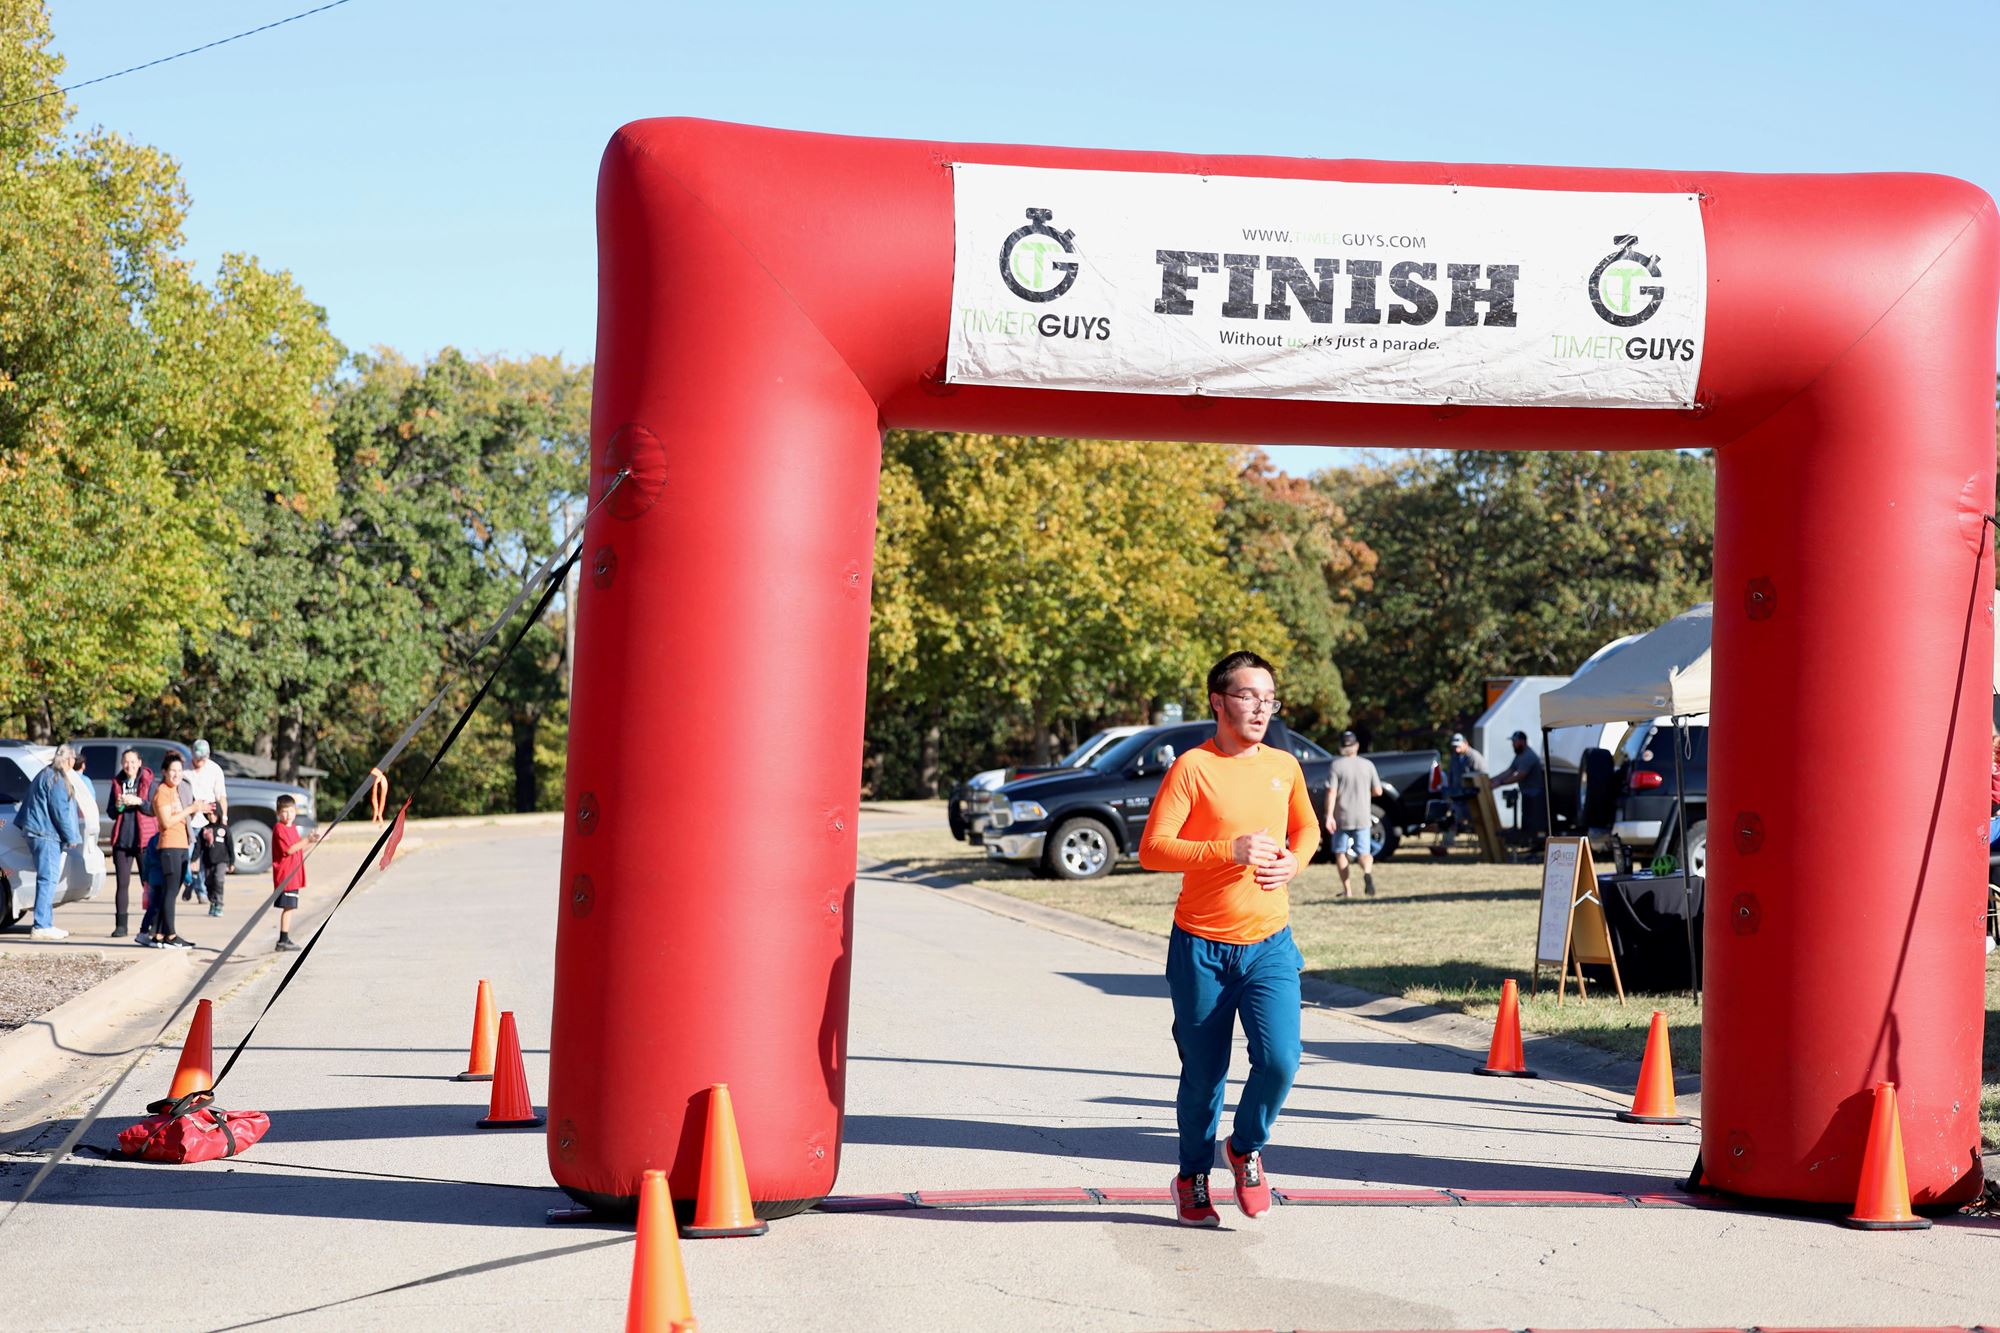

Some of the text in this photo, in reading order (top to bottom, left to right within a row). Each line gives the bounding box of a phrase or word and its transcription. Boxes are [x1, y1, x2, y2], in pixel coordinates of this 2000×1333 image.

[1154, 249, 1520, 328] FINISH
[961, 308, 1111, 341] TIMERGUYS
[1219, 330, 1283, 347] Without
[1312, 334, 1333, 347] it's
[1335, 335, 1366, 350] just
[1369, 338, 1378, 349] a
[1382, 338, 1440, 353] parade.
[1551, 334, 1695, 361] TIMERGUYS
